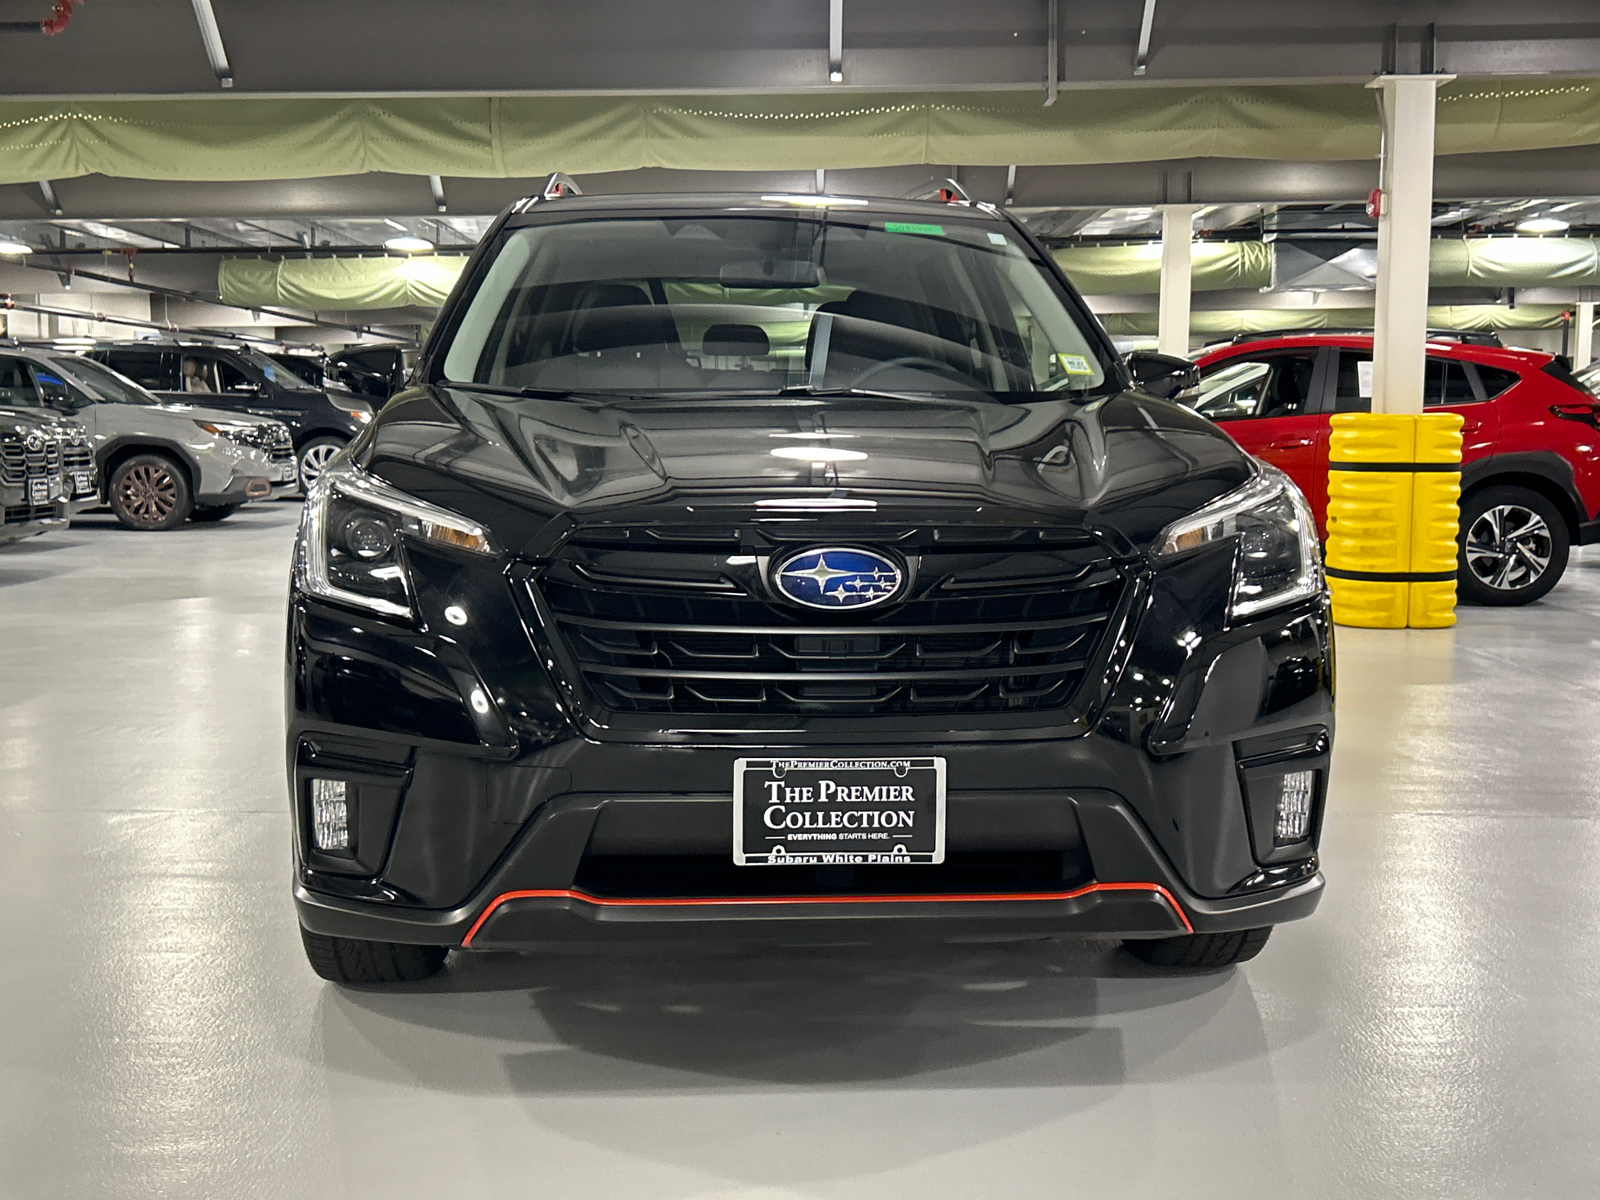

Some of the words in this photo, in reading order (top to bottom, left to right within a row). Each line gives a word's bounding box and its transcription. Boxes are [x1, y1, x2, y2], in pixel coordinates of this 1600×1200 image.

[764, 780, 814, 803] THE
[818, 780, 915, 802] PREMIER
[763, 805, 915, 829] COLLECTION
[787, 833, 837, 841] EVERYTHING
[838, 832, 867, 840] STARTS
[767, 855, 818, 864] Subaru
[822, 854, 863, 863] White
[868, 854, 911, 863] Plains
